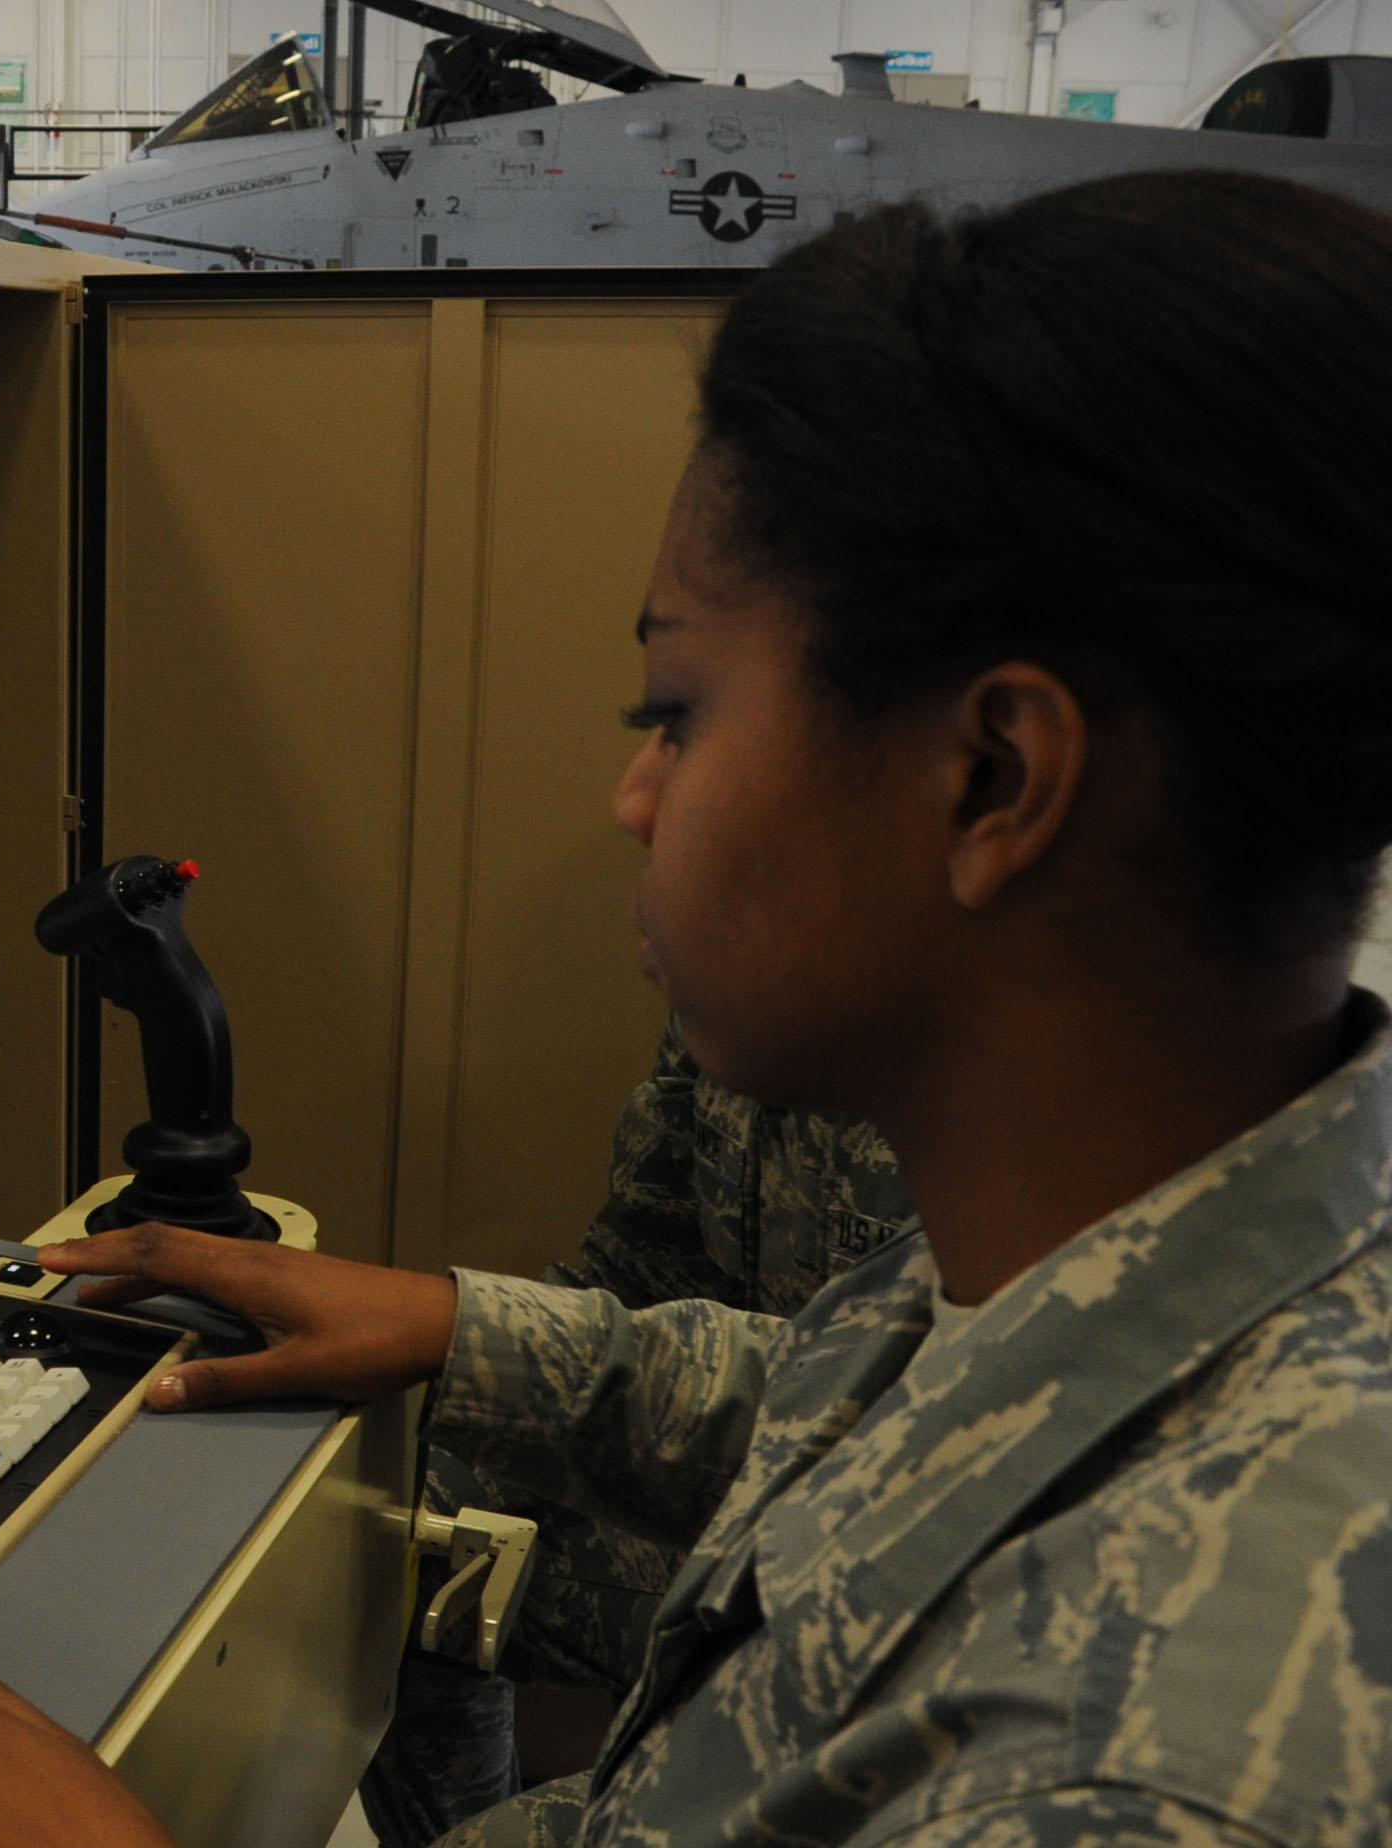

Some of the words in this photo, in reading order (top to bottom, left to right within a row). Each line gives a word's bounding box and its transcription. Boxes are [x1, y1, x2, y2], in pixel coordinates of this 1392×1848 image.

[146, 202, 168, 213] COL
[171, 192, 213, 207] PATRICK
[216, 175, 293, 196] MALACKOWSKI
